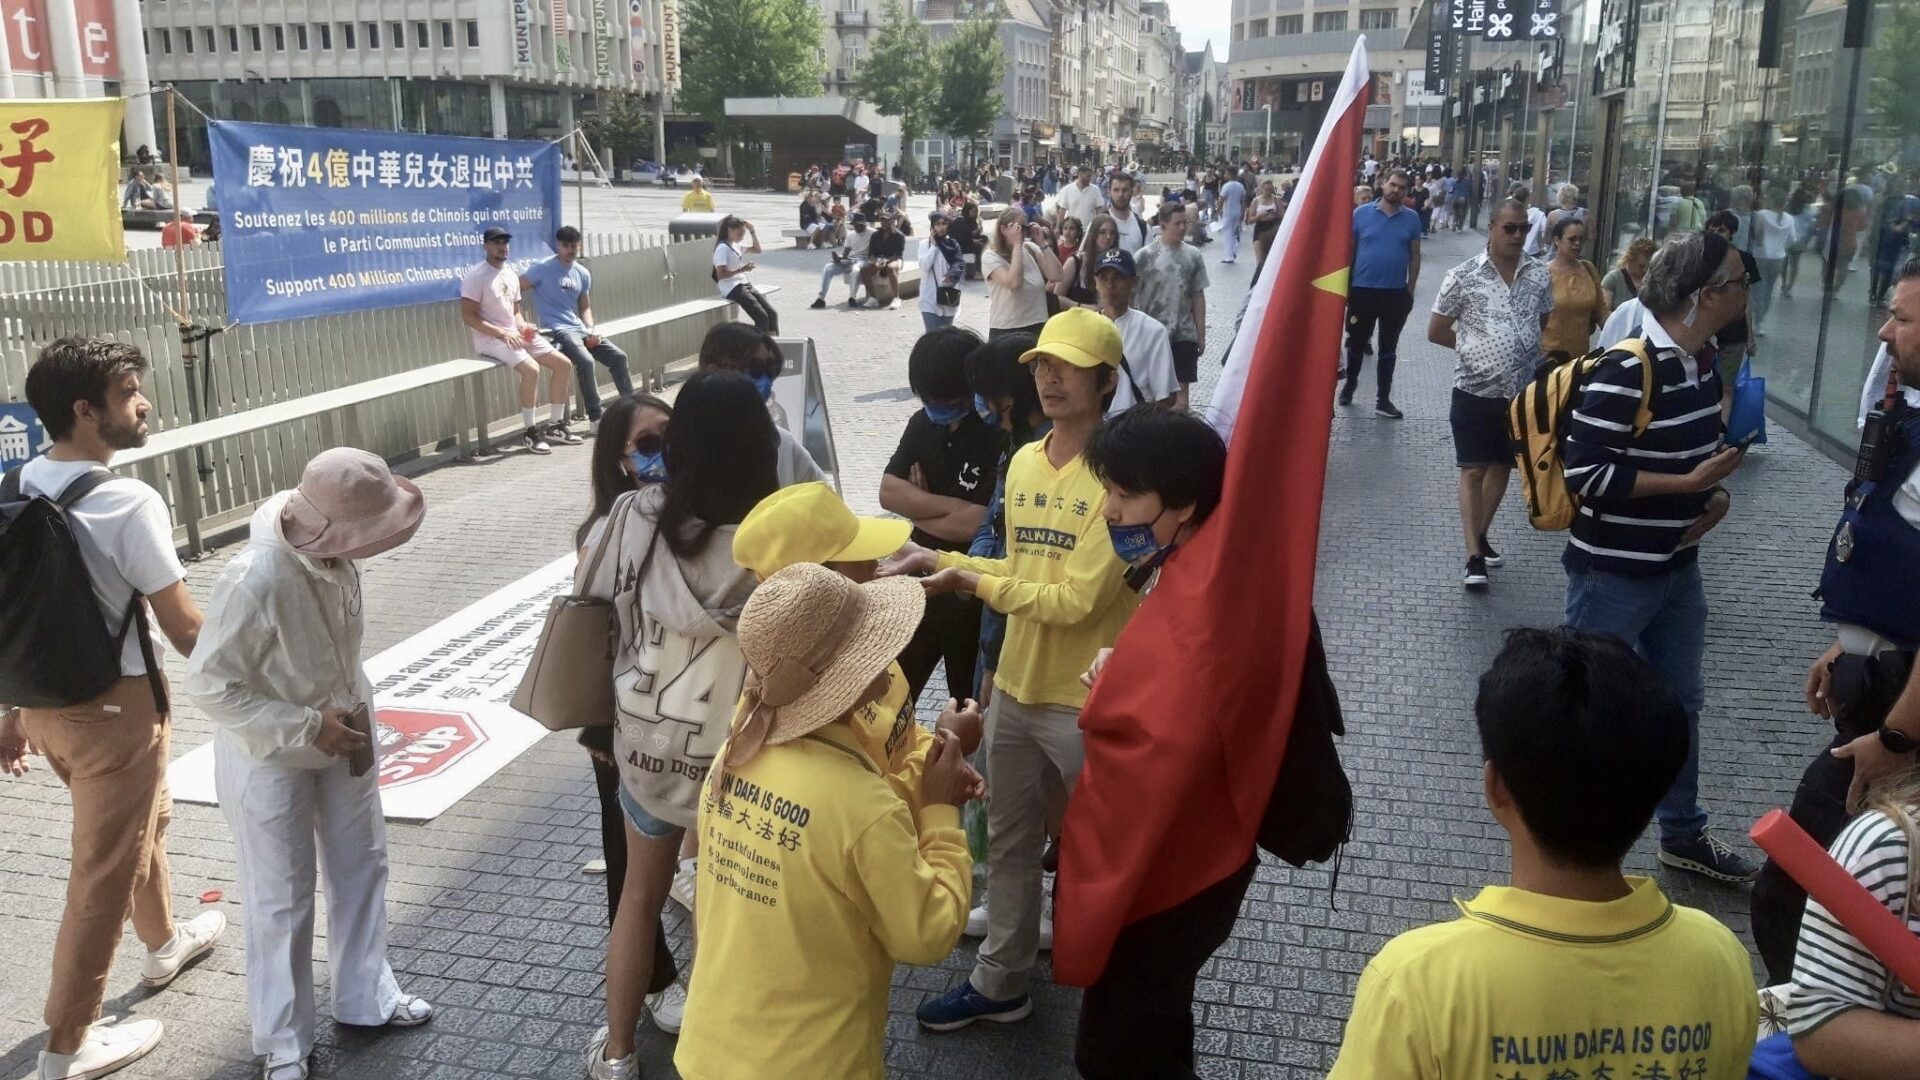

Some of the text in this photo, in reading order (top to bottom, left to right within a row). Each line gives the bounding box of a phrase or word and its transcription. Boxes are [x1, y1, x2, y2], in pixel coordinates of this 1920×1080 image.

[514, 0, 530, 63] MUNTP
[663, 4, 677, 82] MUNTPUNT
[234, 206, 544, 229] Soutenez les 400 millions de Chinois qui ont quitté
[323, 231, 485, 254] le Parti Communist Chinois
[266, 276, 327, 297] Support
[329, 272, 356, 290] 400
[359, 269, 404, 287] Million
[406, 265, 452, 283] Chinese
[733, 777, 761, 806] DAFA
[760, 789, 774, 812] IS
[773, 797, 811, 828] GOOD
[717, 831, 781, 873] Truthfulness
[713, 870, 777, 906] orbearance
[1490, 1020, 1713, 1065] FALUN DAFA IS GOOD
